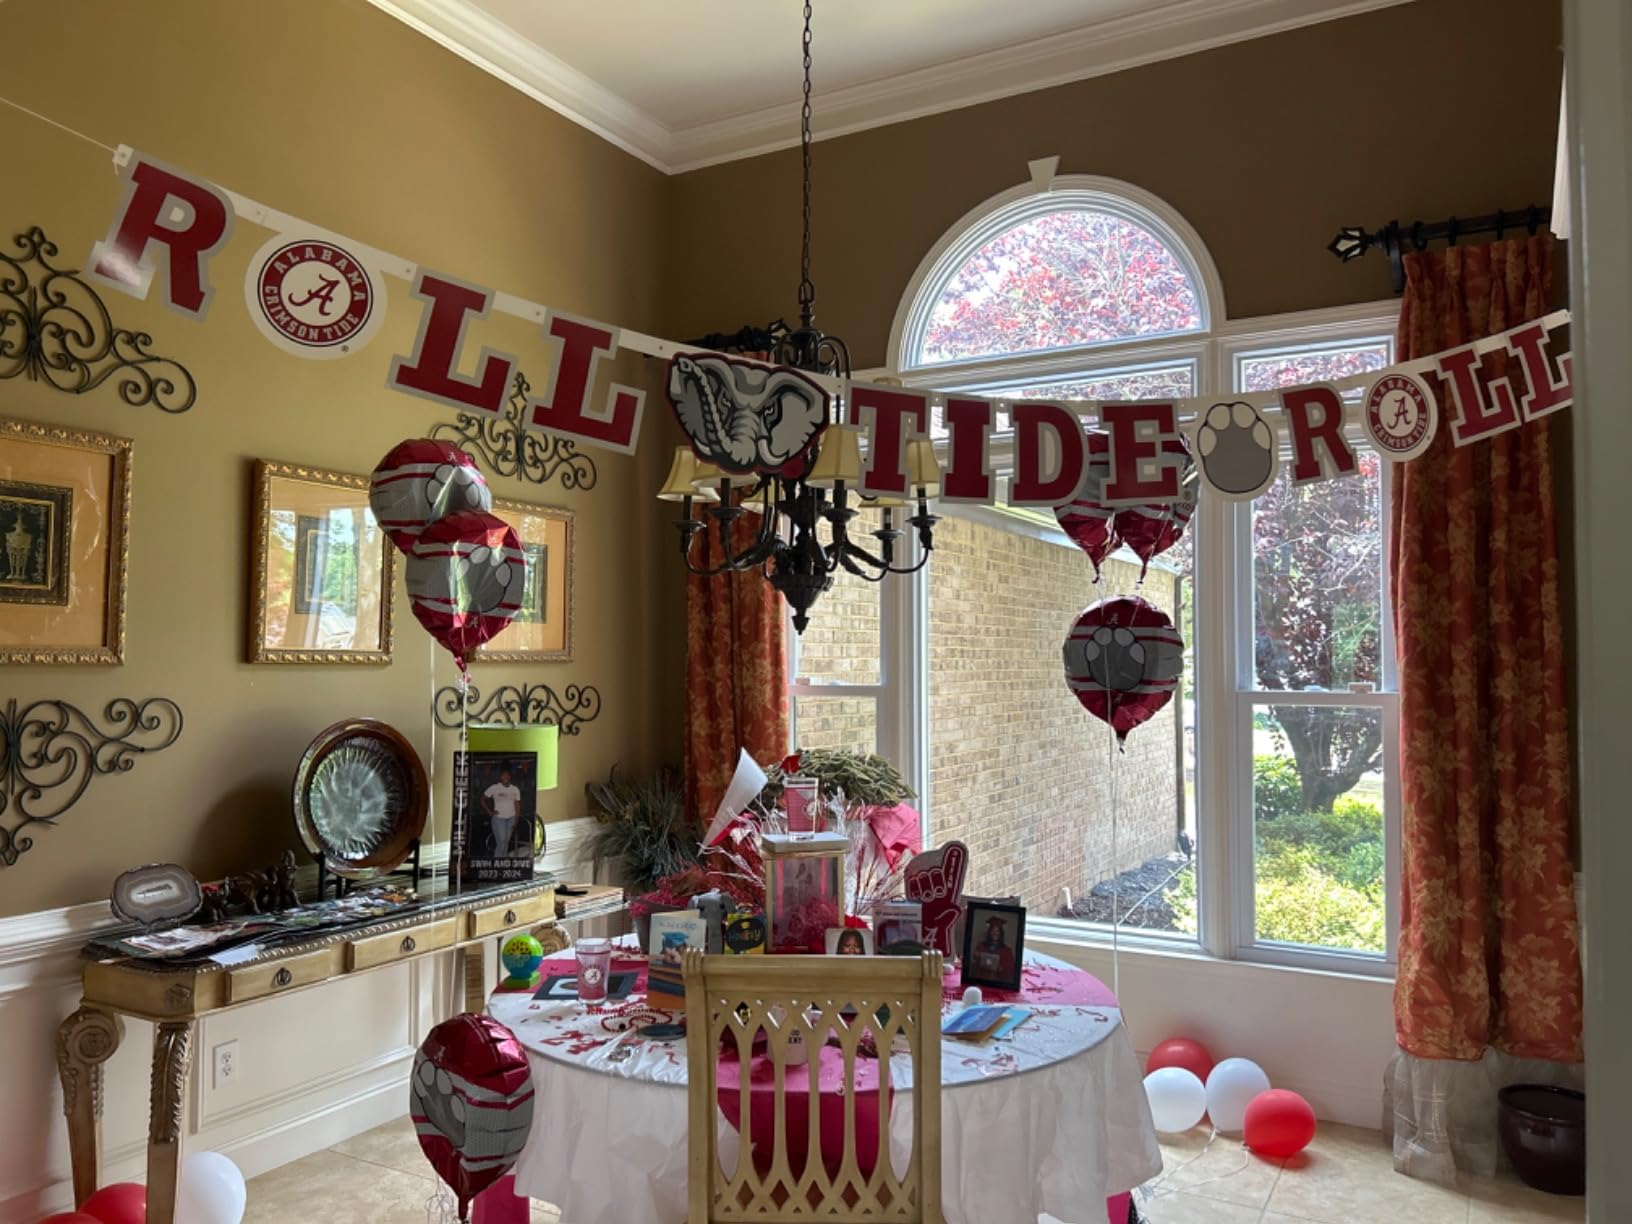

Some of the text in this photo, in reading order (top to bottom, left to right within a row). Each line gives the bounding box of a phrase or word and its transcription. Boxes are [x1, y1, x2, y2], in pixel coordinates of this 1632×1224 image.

[274, 246, 365, 301] ALABAMA
[264, 285, 360, 341] CRIMSON TIDE
[1370, 379, 1422, 413] ALABAMA
[850, 387, 1180, 501] TIDE
[454, 752, 469, 809] CREEK
